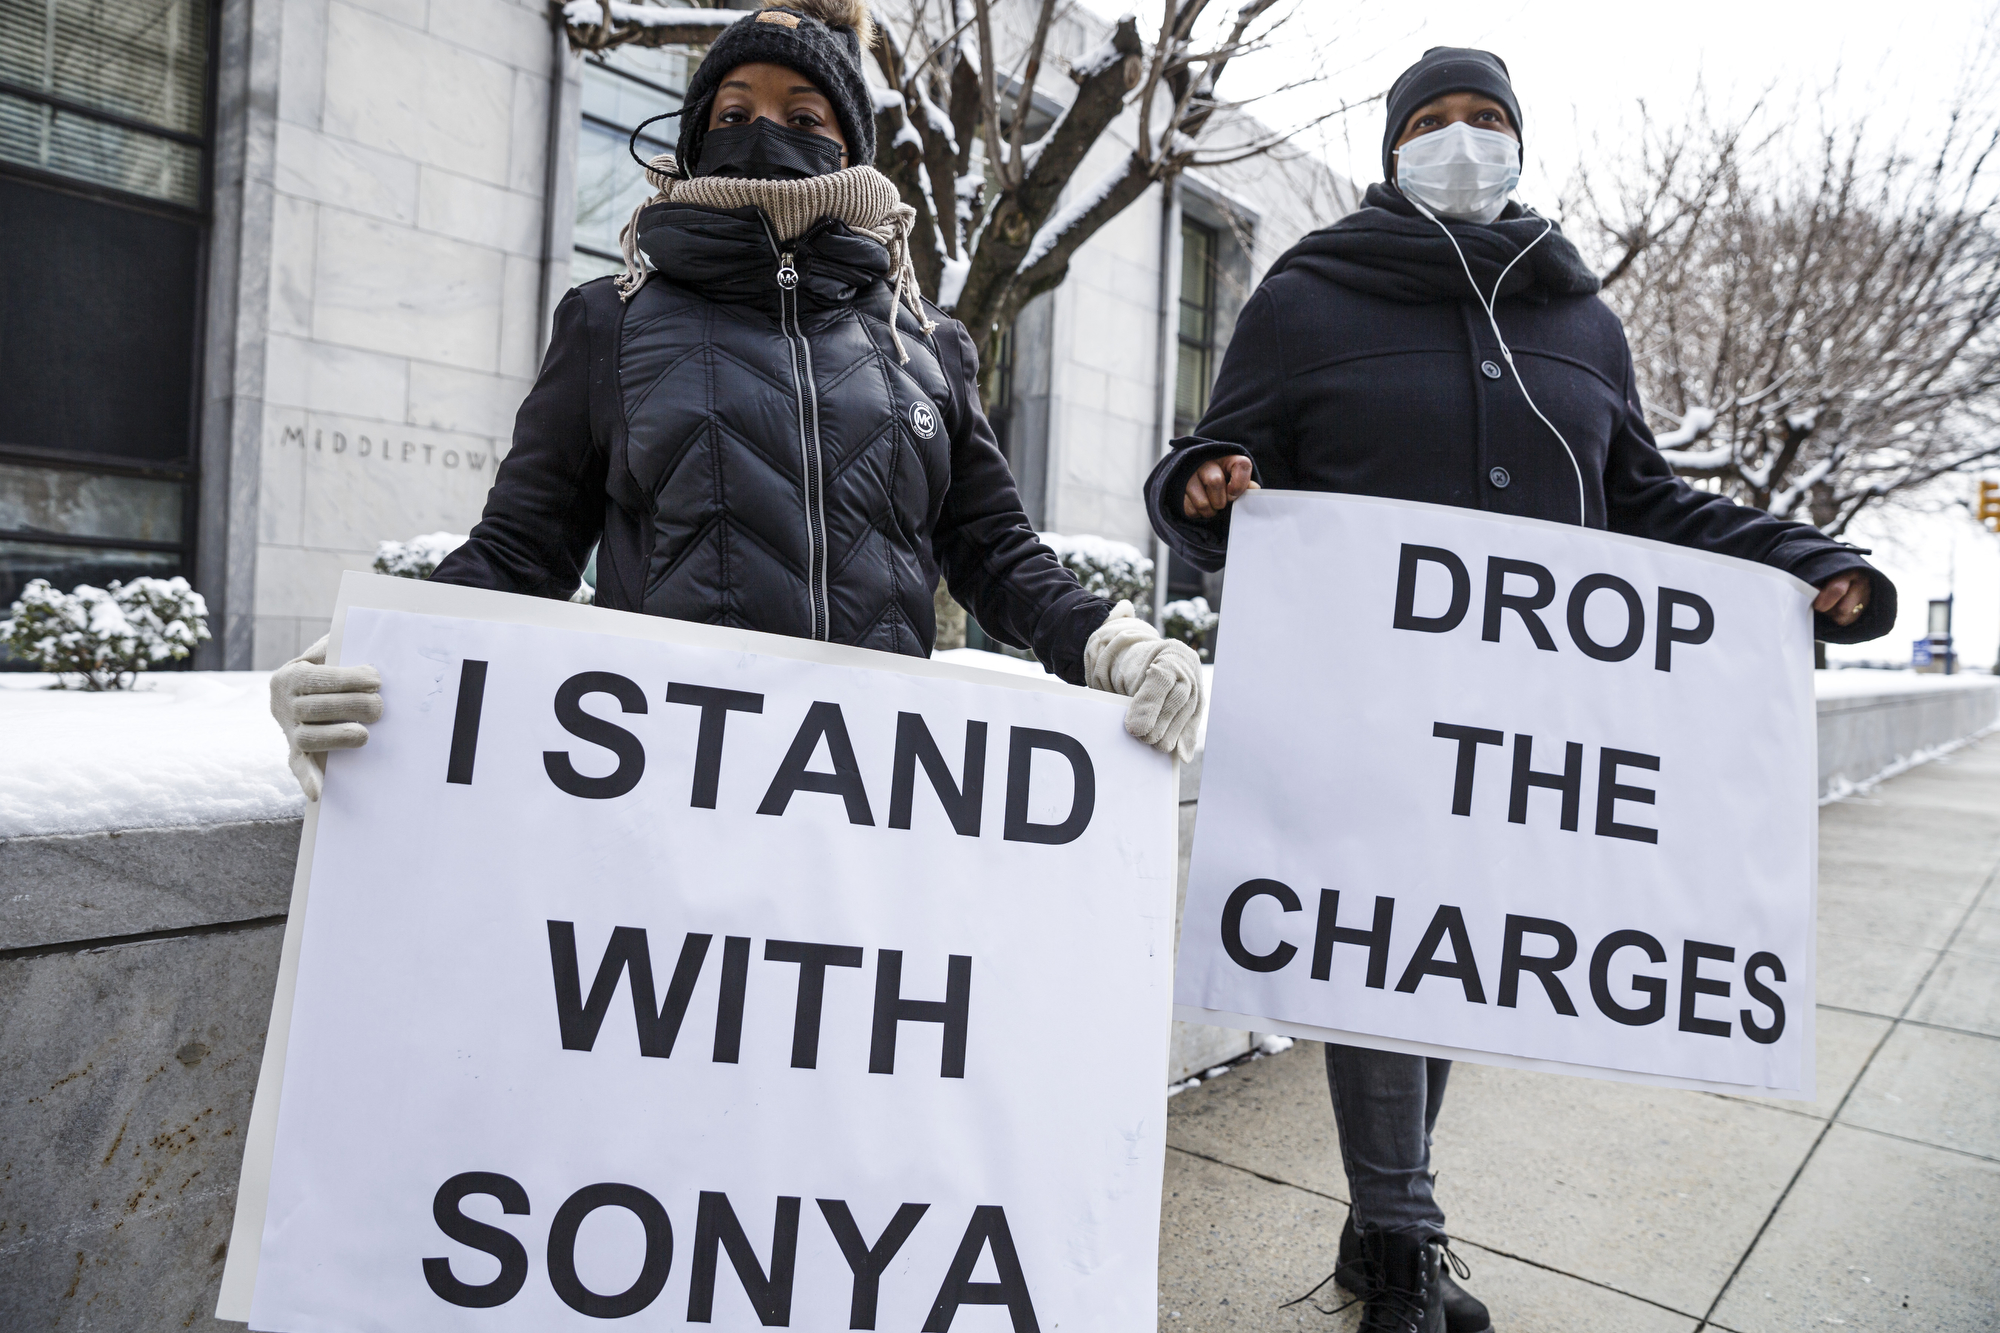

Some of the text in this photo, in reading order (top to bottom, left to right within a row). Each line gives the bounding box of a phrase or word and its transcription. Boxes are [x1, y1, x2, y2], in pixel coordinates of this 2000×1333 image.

[1393, 543, 1714, 672] DROP
[447, 659, 1095, 844] I STAND
[1433, 722, 1660, 844] THE
[547, 920, 972, 1078] WITH
[1221, 878, 1786, 1045] CHARGES
[422, 1171, 1041, 1333] SONYA
